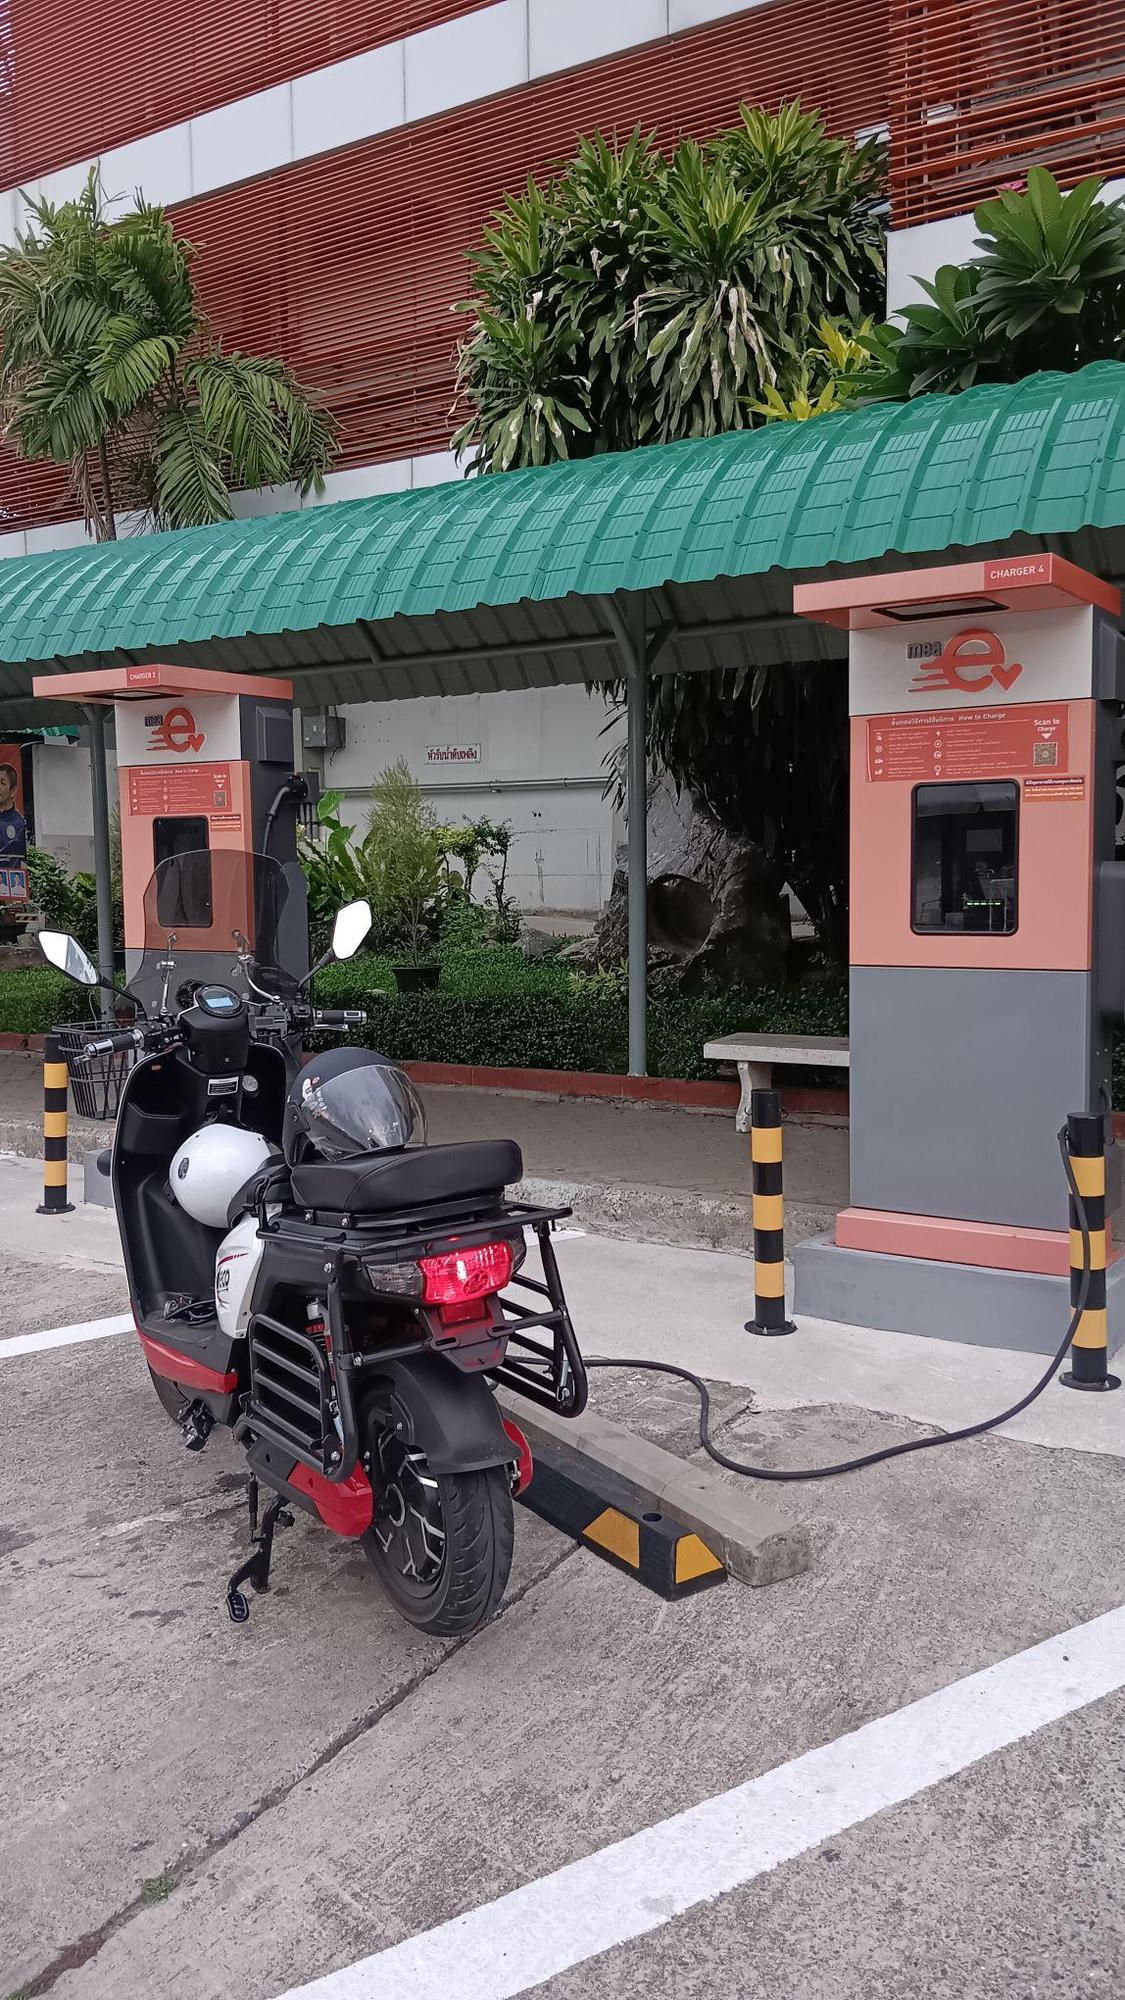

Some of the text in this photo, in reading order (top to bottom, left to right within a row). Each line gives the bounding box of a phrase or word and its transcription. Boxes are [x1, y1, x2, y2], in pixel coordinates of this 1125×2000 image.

[990, 565, 1044, 579] CHARGER 4
[907, 641, 942, 659] mea
[129, 672, 152, 681] CHARGER
[982, 712, 1006, 721] Charge
[1037, 725, 1056, 733] Charge
